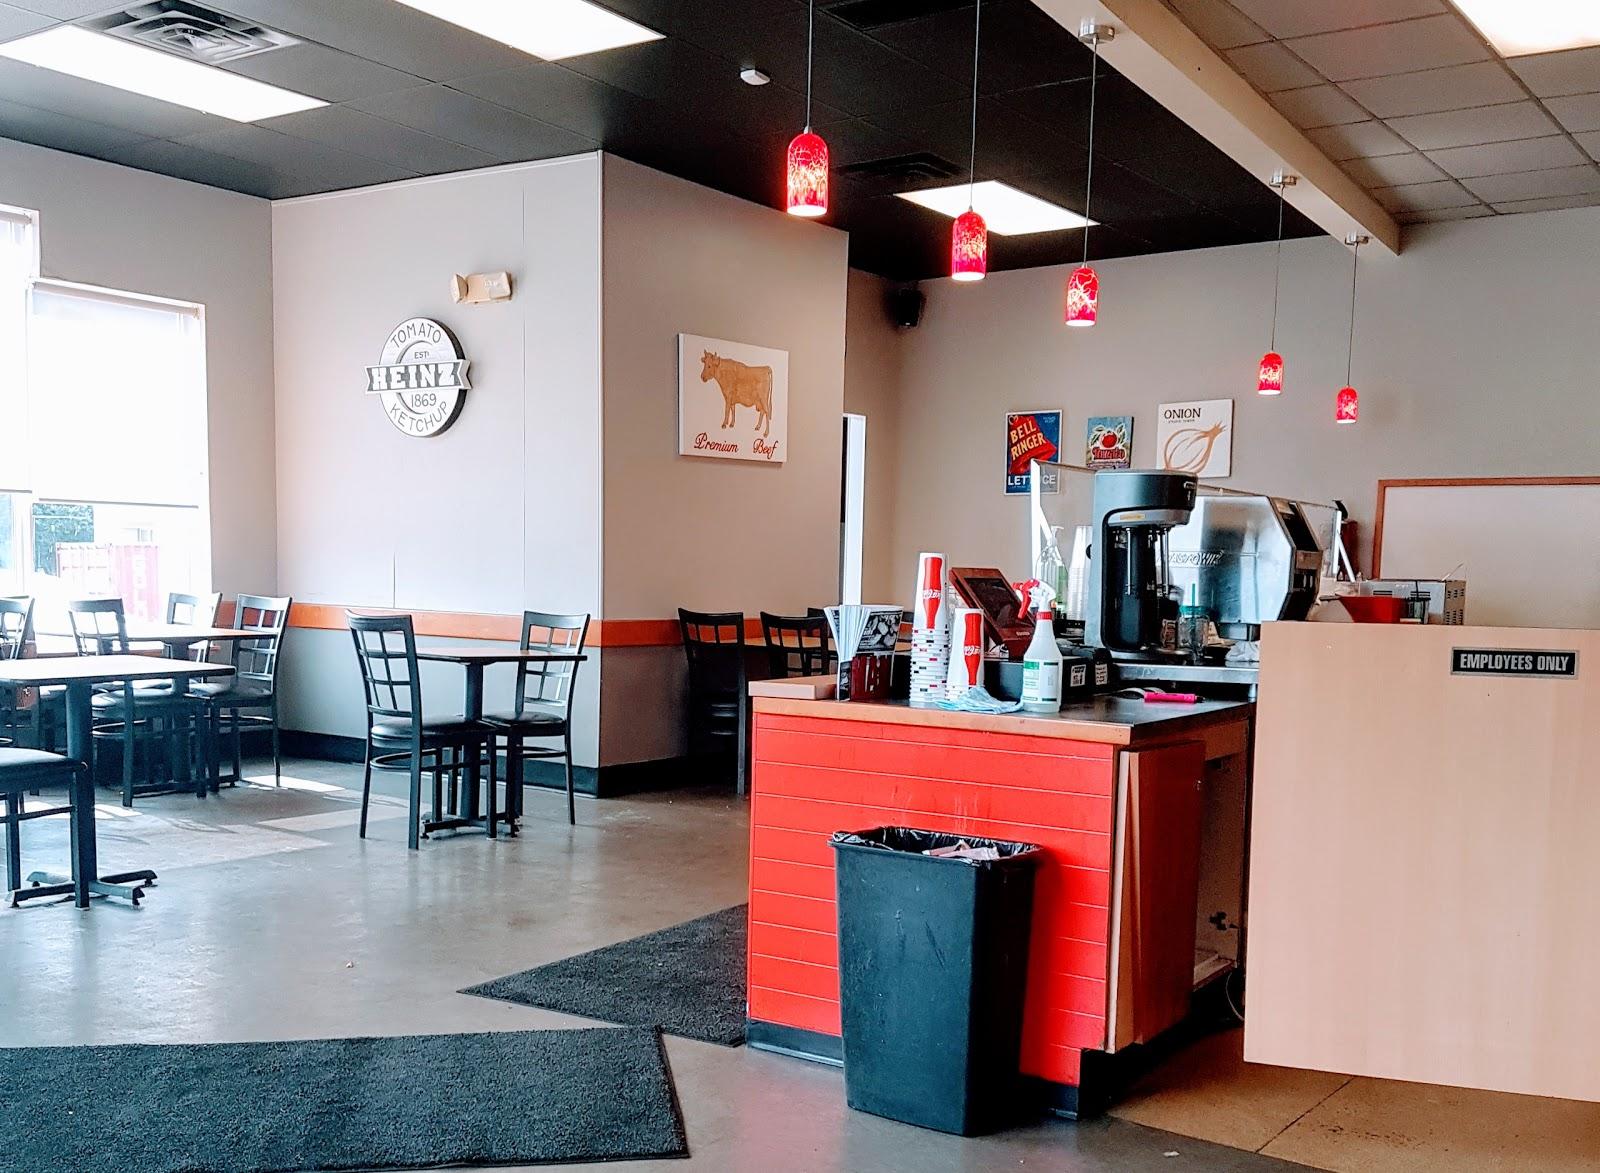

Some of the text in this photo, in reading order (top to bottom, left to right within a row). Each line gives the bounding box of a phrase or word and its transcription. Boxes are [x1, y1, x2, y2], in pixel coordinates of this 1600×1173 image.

[390, 322, 441, 348] TOMATO
[371, 362, 455, 391] HEINZ
[411, 393, 437, 408] 1869
[1163, 407, 1201, 419] ONION
[390, 401, 448, 432] KETCHUP
[1010, 420, 1037, 444] BELL
[693, 432, 779, 459] Premium Beef
[1010, 432, 1047, 461] RINGER
[1460, 653, 1569, 671] EMPLOYEES ONLY
